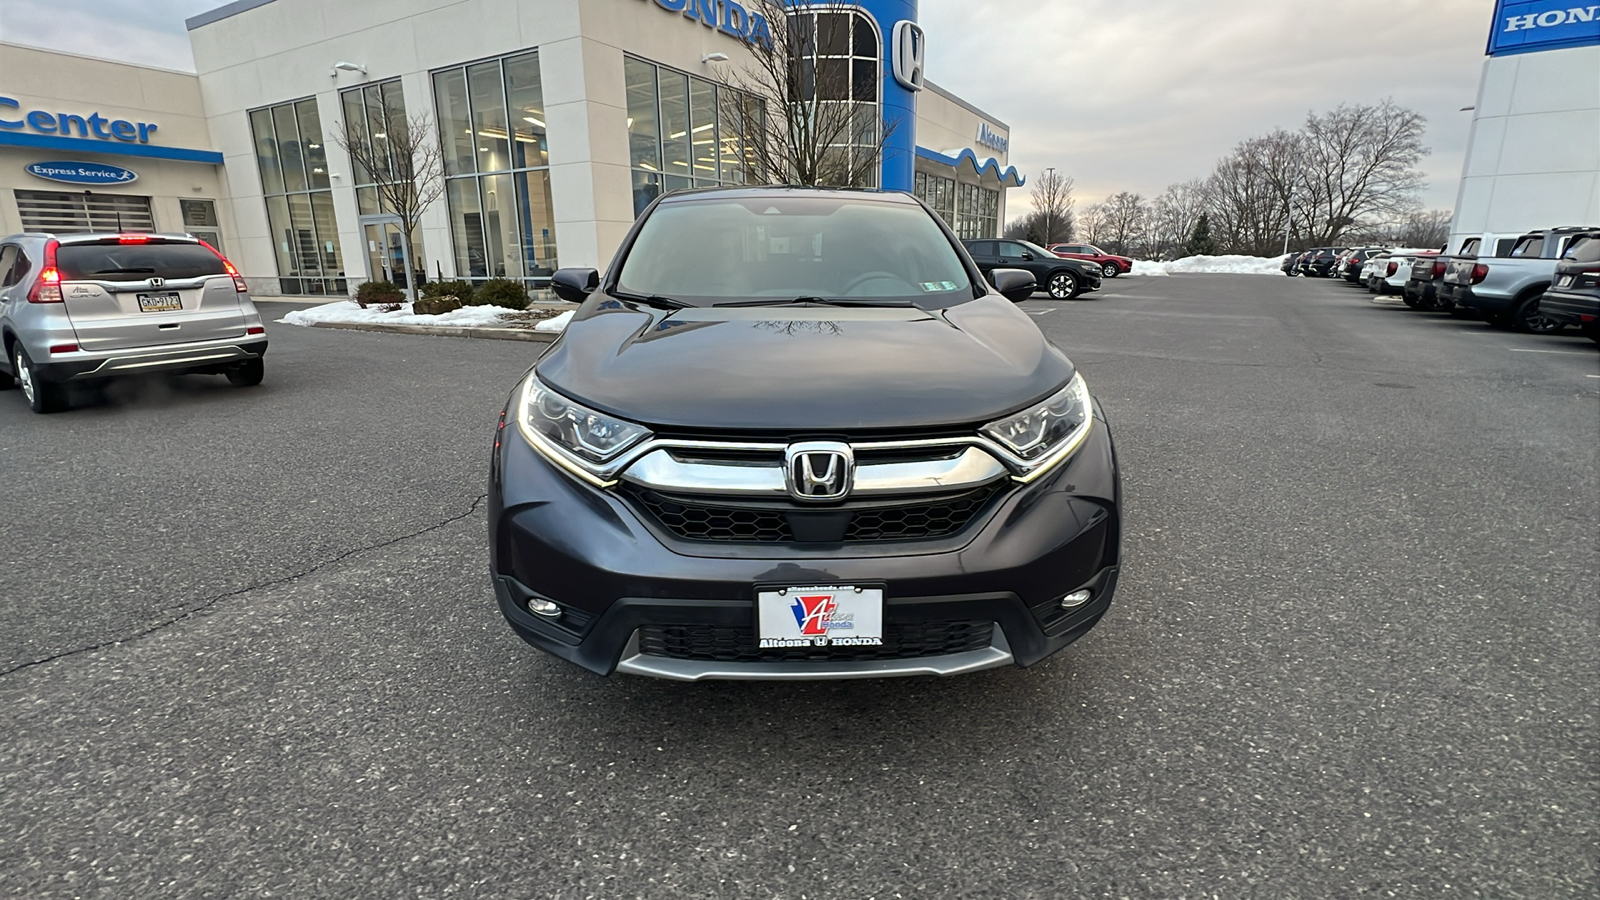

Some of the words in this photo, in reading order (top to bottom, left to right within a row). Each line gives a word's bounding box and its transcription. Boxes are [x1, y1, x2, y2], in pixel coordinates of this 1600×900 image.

[1503, 5, 1600, 32] HON
[33, 165, 76, 176] Express
[78, 168, 117, 178] Service
[822, 621, 853, 629] Honda
[759, 638, 811, 648] Altoona
[831, 637, 883, 646] HONDA
